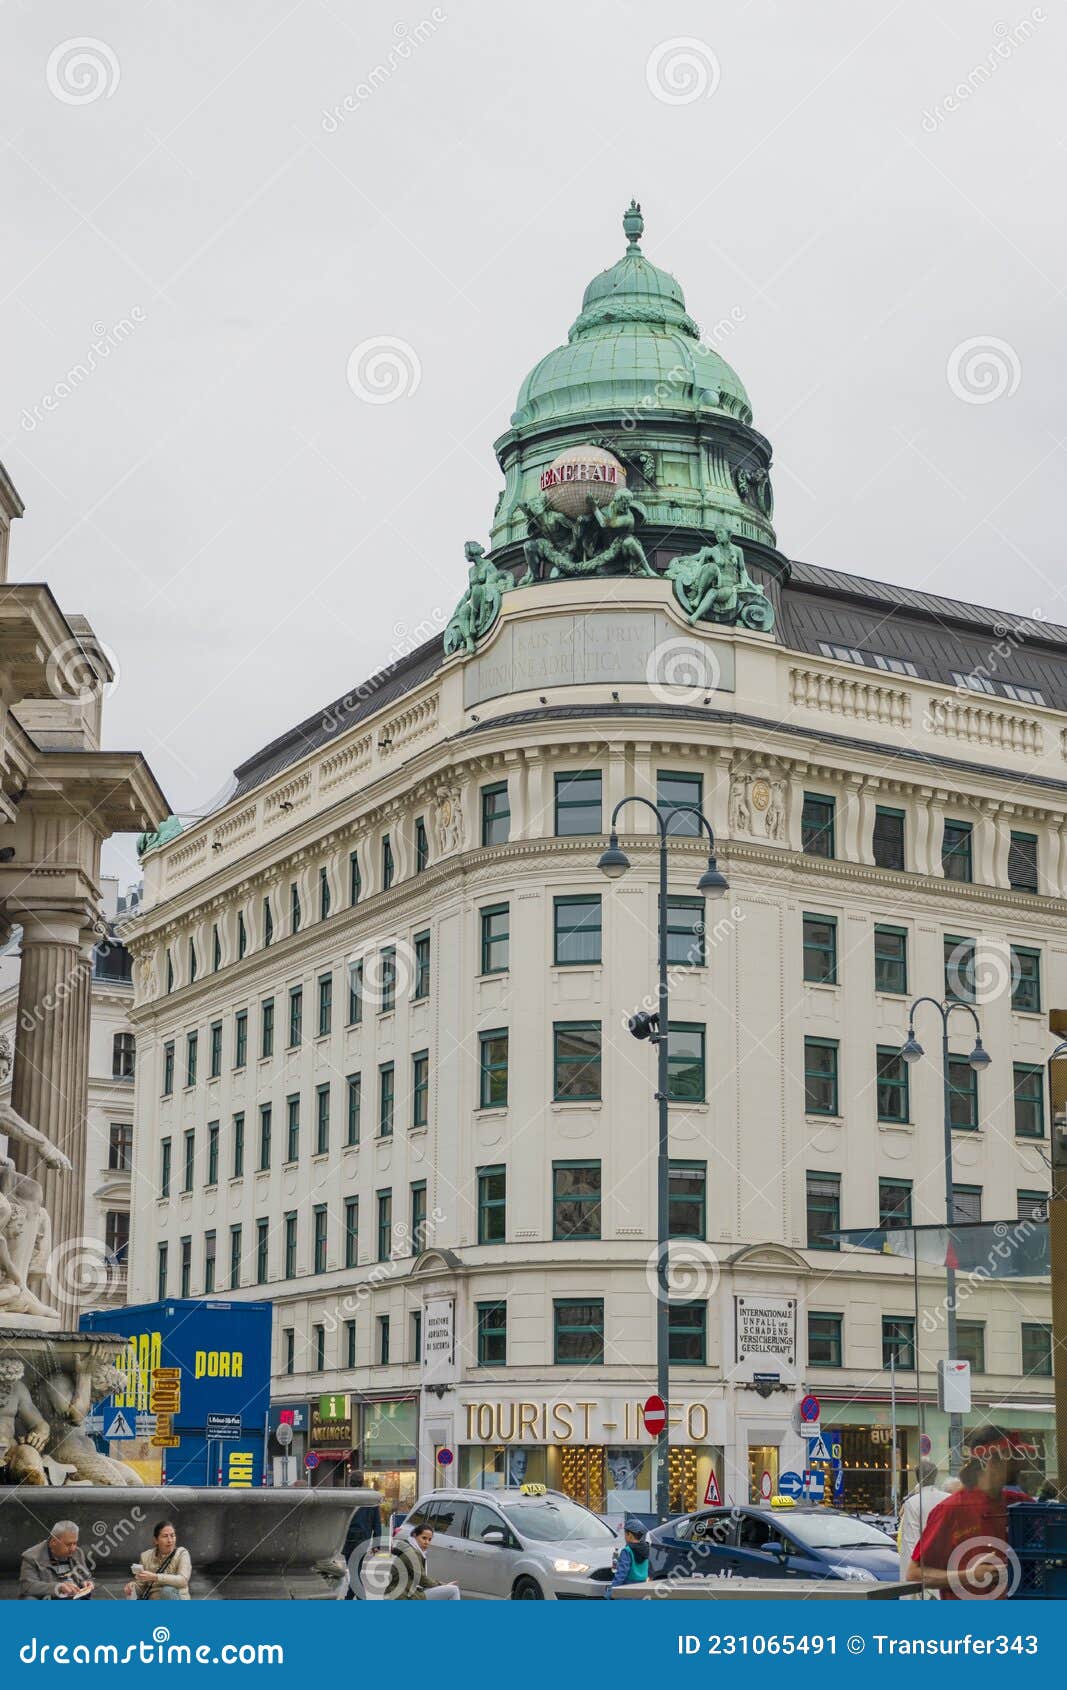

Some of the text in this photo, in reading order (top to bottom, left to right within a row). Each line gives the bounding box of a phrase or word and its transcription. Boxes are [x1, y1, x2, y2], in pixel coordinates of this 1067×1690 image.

[740, 1308, 793, 1319] INTERNATIONALE
[743, 1317, 777, 1327] UNFALL
[743, 1326, 789, 1336] SCHADENS
[739, 1335, 793, 1346] VERSICHERUNGS
[741, 1344, 792, 1354] GESELLSCHAFT
[195, 1351, 243, 1378] PORR
